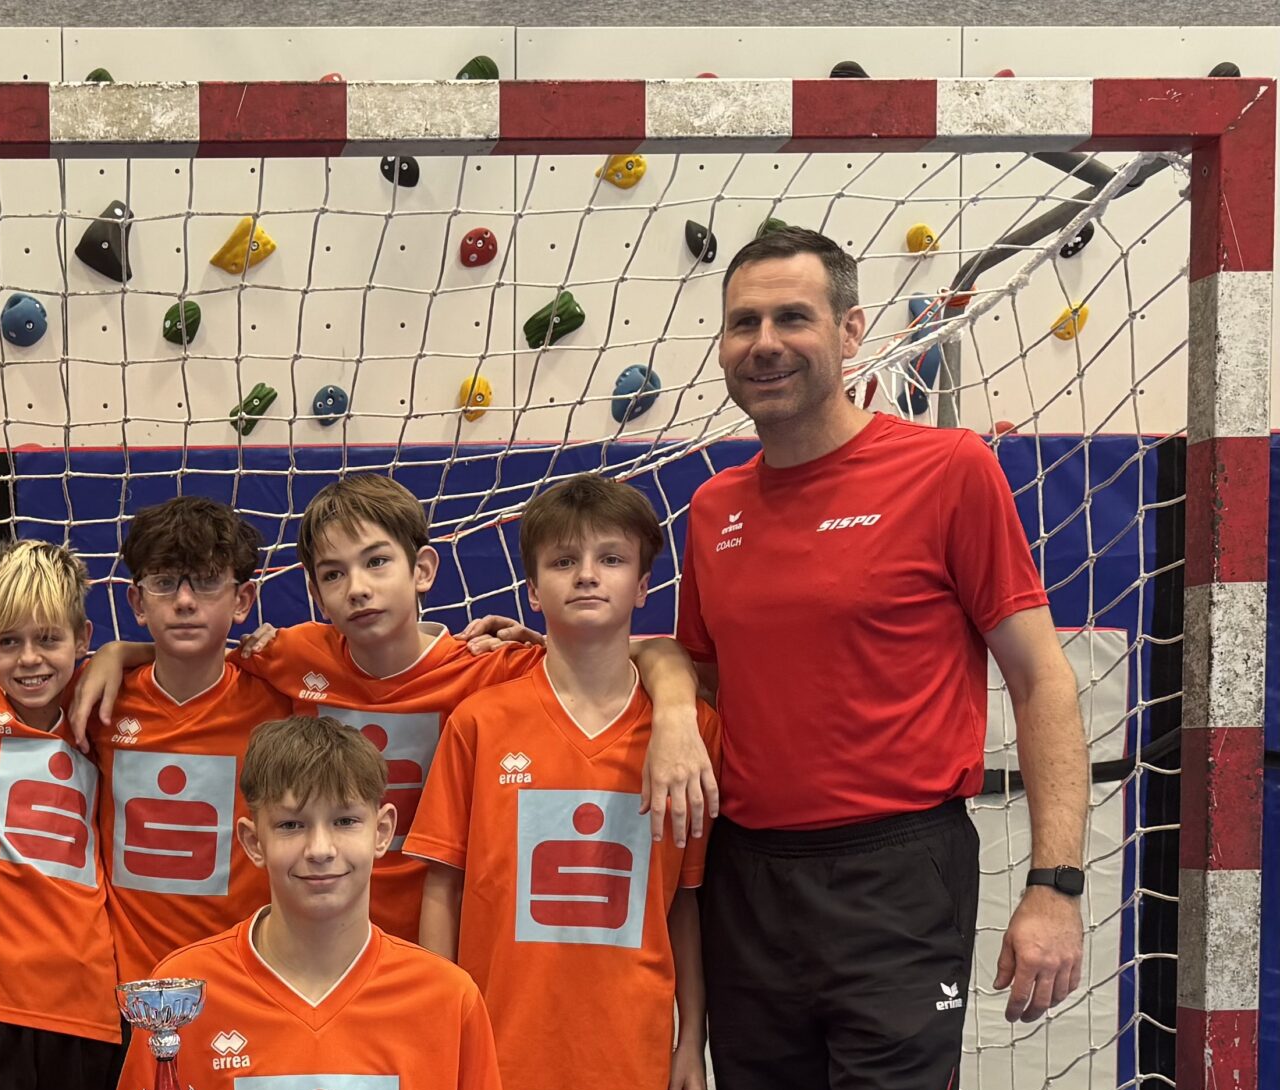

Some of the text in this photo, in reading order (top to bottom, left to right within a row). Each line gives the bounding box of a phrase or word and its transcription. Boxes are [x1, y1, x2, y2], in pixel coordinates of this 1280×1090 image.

[816, 513, 882, 532] SISPO
[716, 537, 743, 552] COACH
[499, 772, 532, 785] errea
[212, 1054, 251, 1071] errea
